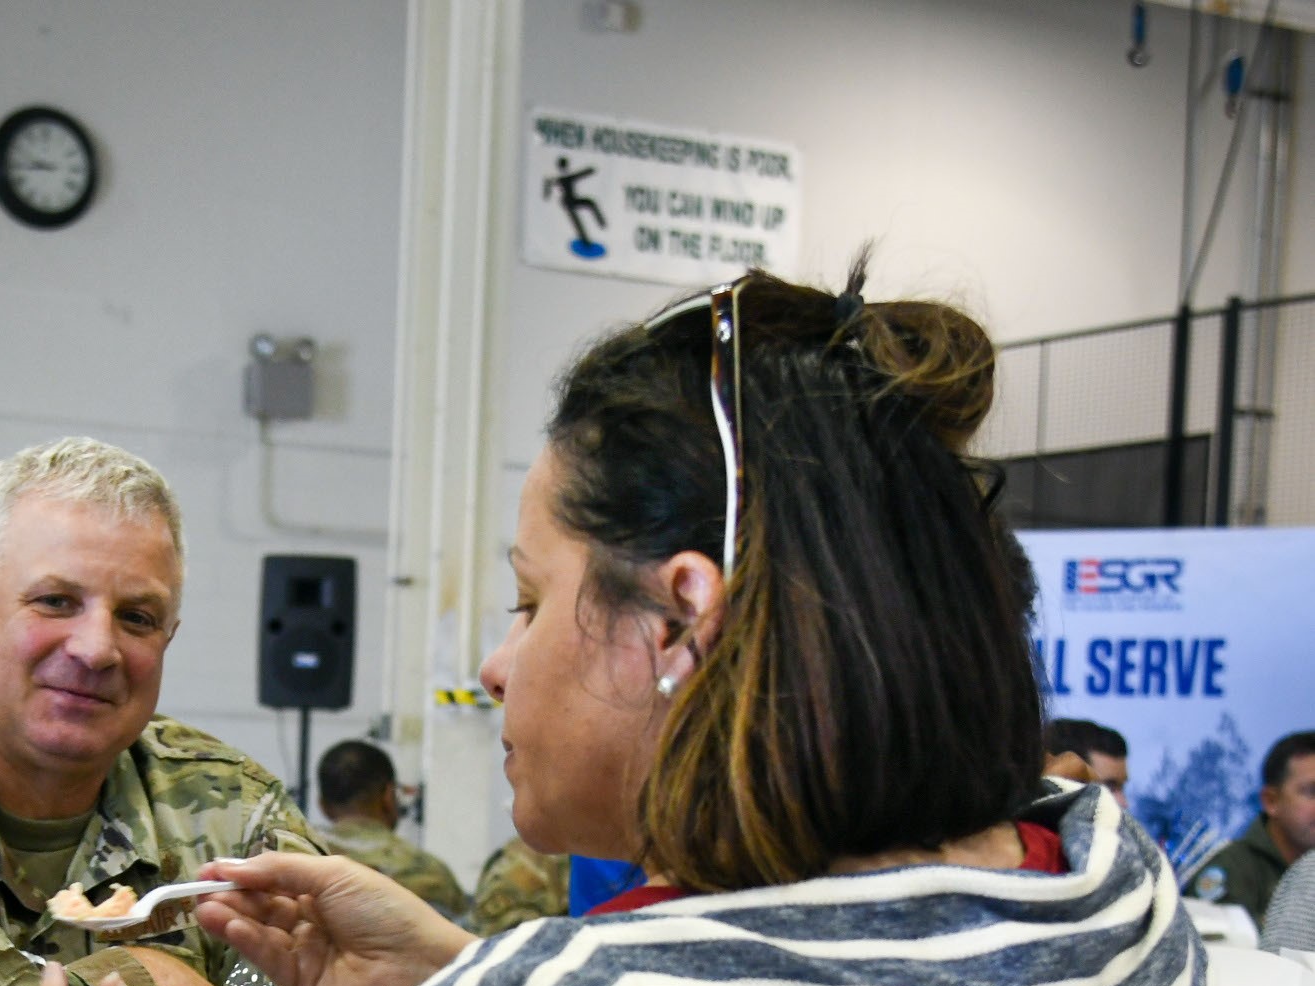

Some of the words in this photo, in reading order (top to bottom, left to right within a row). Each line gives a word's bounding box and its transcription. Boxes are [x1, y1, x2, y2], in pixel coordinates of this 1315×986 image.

[536, 118, 584, 149] WHEN
[593, 126, 719, 169] HOUSEKEEPING
[728, 146, 740, 172] IS
[625, 186, 659, 214] YOU
[668, 190, 703, 217] CAN
[711, 198, 754, 228] WIND
[761, 205, 784, 230] UP
[634, 226, 661, 252] ON
[668, 230, 701, 259] THE
[1086, 637, 1226, 697] SERVE
